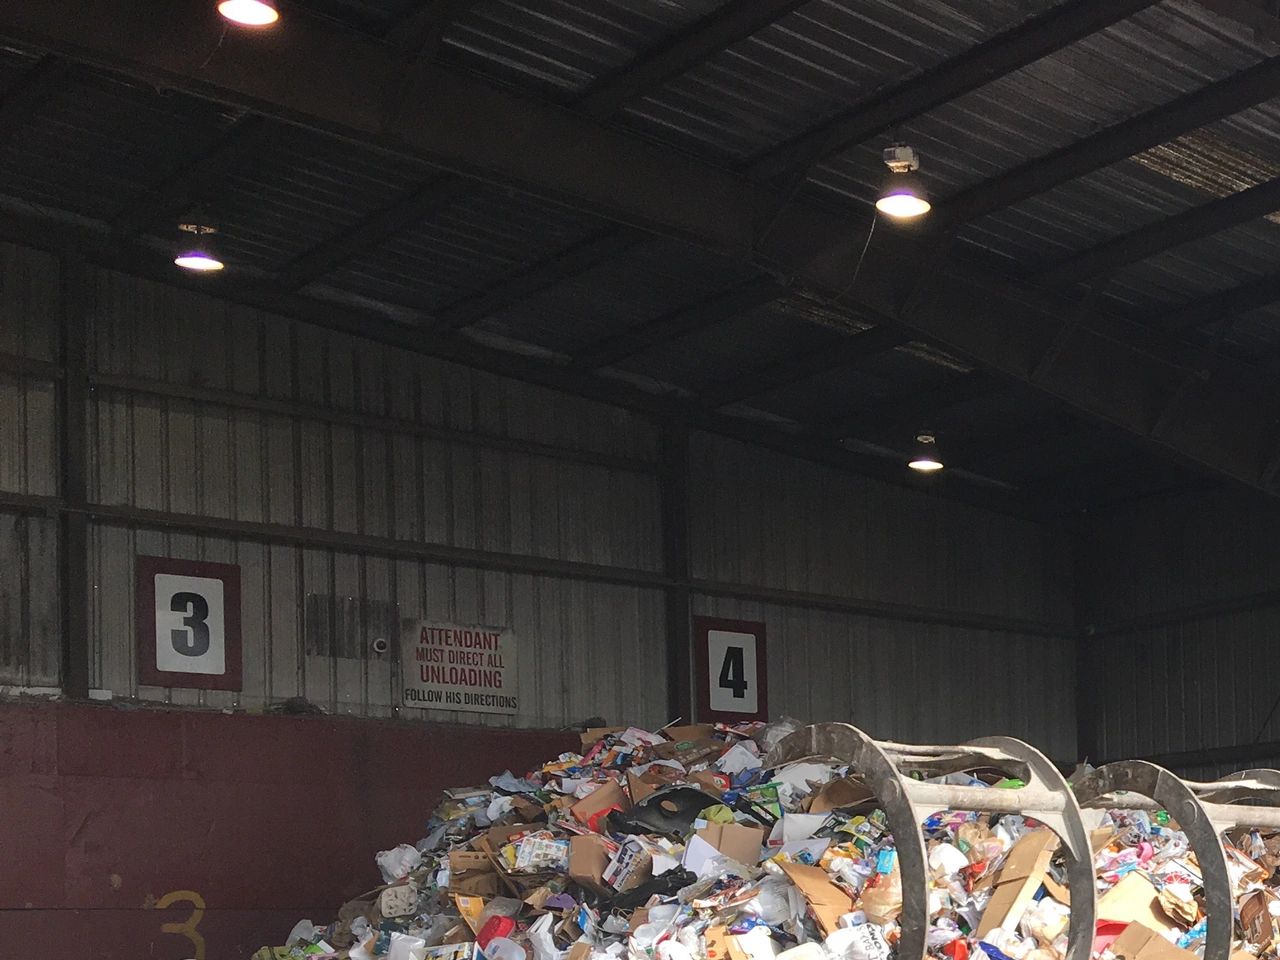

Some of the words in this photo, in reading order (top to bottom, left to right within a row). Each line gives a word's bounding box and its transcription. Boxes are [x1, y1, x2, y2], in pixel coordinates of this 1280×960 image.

[170, 591, 210, 657] 3
[419, 626, 501, 651] ATTENDANT
[415, 646, 445, 663] MUST
[448, 649, 485, 667] DIRECT
[487, 653, 505, 669] ALL
[419, 664, 503, 689] UNLOADING
[718, 646, 748, 699] 4
[404, 688, 443, 703] FOLLOW
[445, 690, 462, 705] HIS
[464, 692, 518, 709] DIRECTIONS
